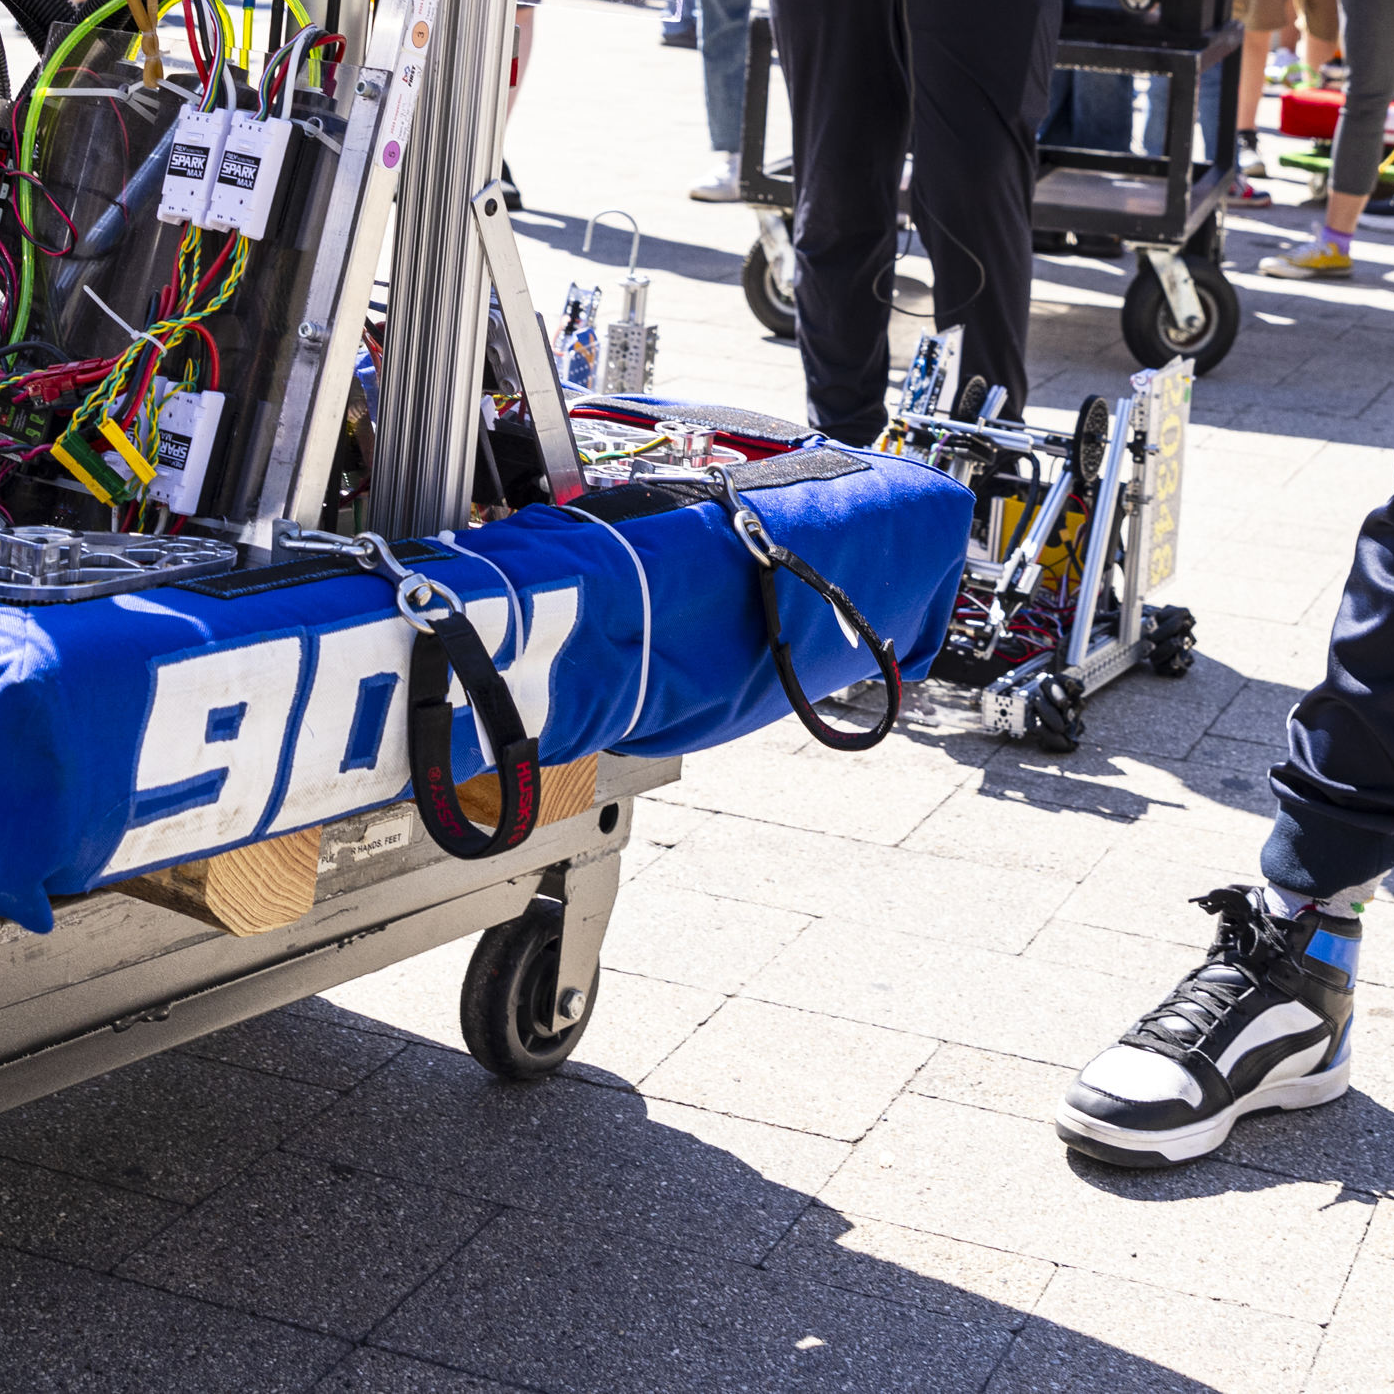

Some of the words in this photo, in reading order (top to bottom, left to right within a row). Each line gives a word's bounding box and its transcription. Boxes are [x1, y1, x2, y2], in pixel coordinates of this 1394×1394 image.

[171, 154, 206, 170] SPARK
[186, 169, 204, 178] MAX
[221, 162, 257, 180] SPARK
[236, 178, 254, 189] MAX
[159, 440, 189, 459] SPAR
[515, 760, 535, 832] HUSKY
[384, 833, 402, 845] FEET
